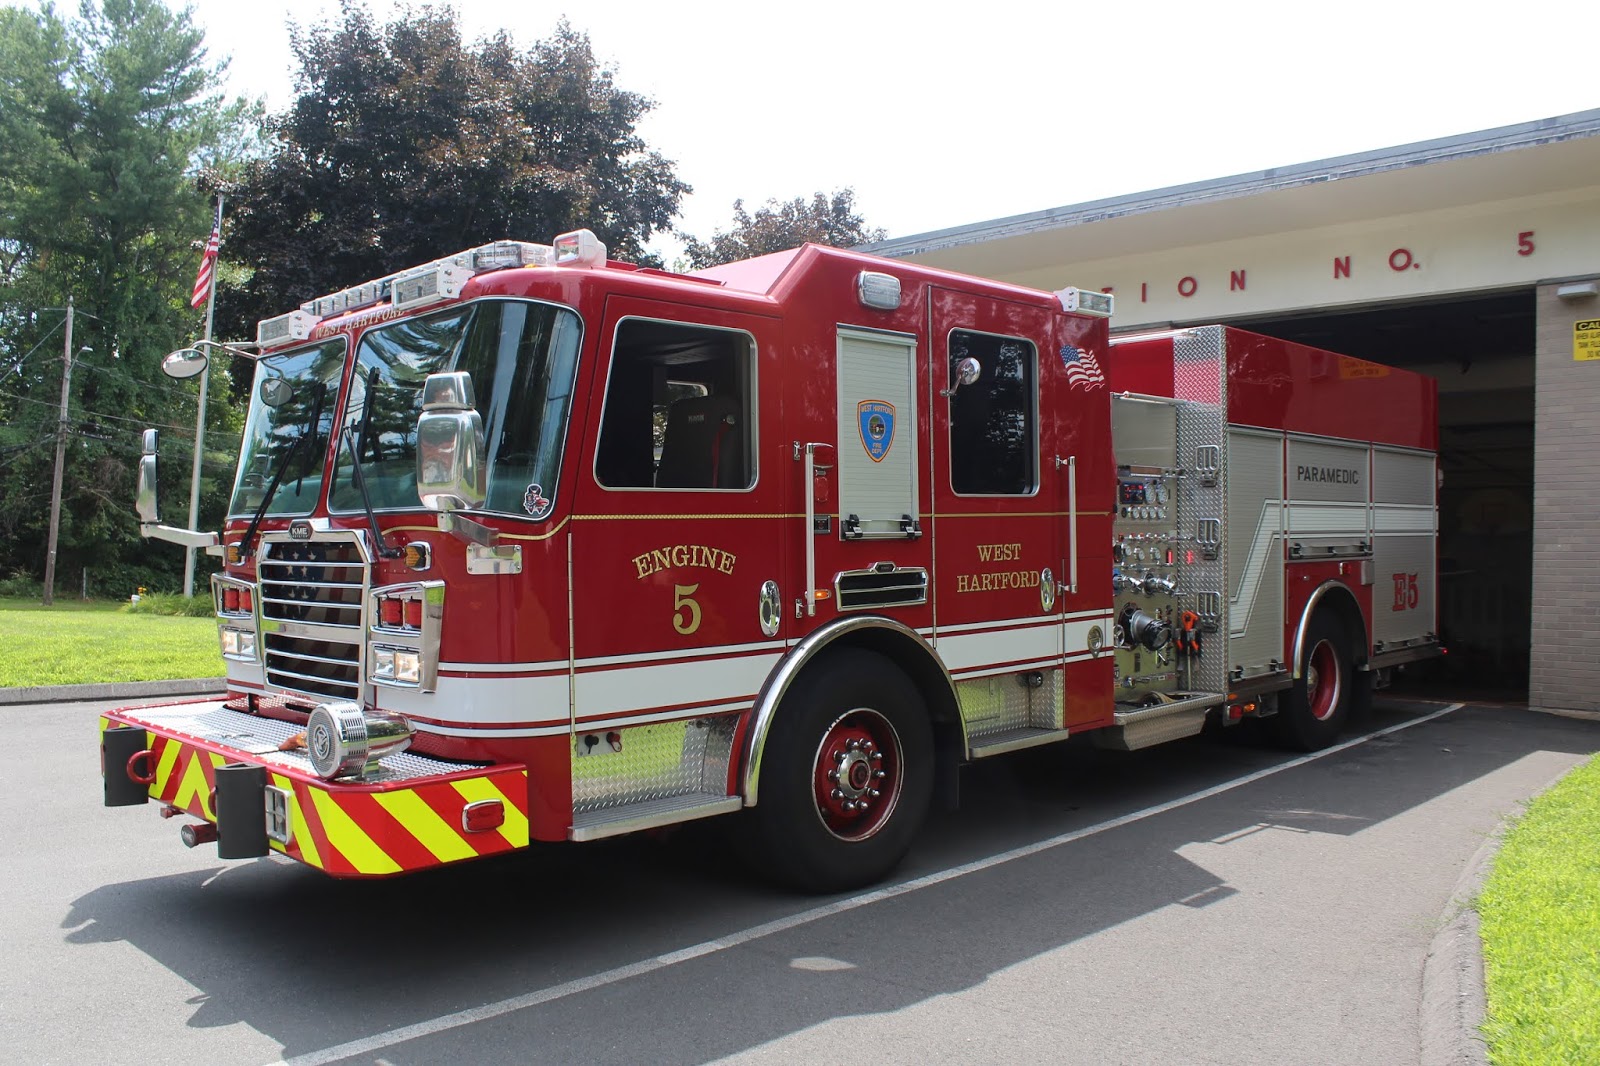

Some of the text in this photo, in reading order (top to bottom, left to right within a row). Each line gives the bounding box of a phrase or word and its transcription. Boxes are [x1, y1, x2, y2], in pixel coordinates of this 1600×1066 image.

[1333, 248, 1420, 279] NO.
[1517, 231, 1535, 256] 5
[315, 322, 343, 339] WEST
[860, 404, 872, 413] WEST
[1297, 466, 1359, 485] PARAMEDIC
[291, 527, 308, 535] KME
[632, 545, 737, 579] ENGINE
[977, 543, 1021, 562] WEST
[957, 570, 1040, 593] HARTFORD
[1392, 572, 1419, 612] E5
[672, 583, 702, 635] 5
